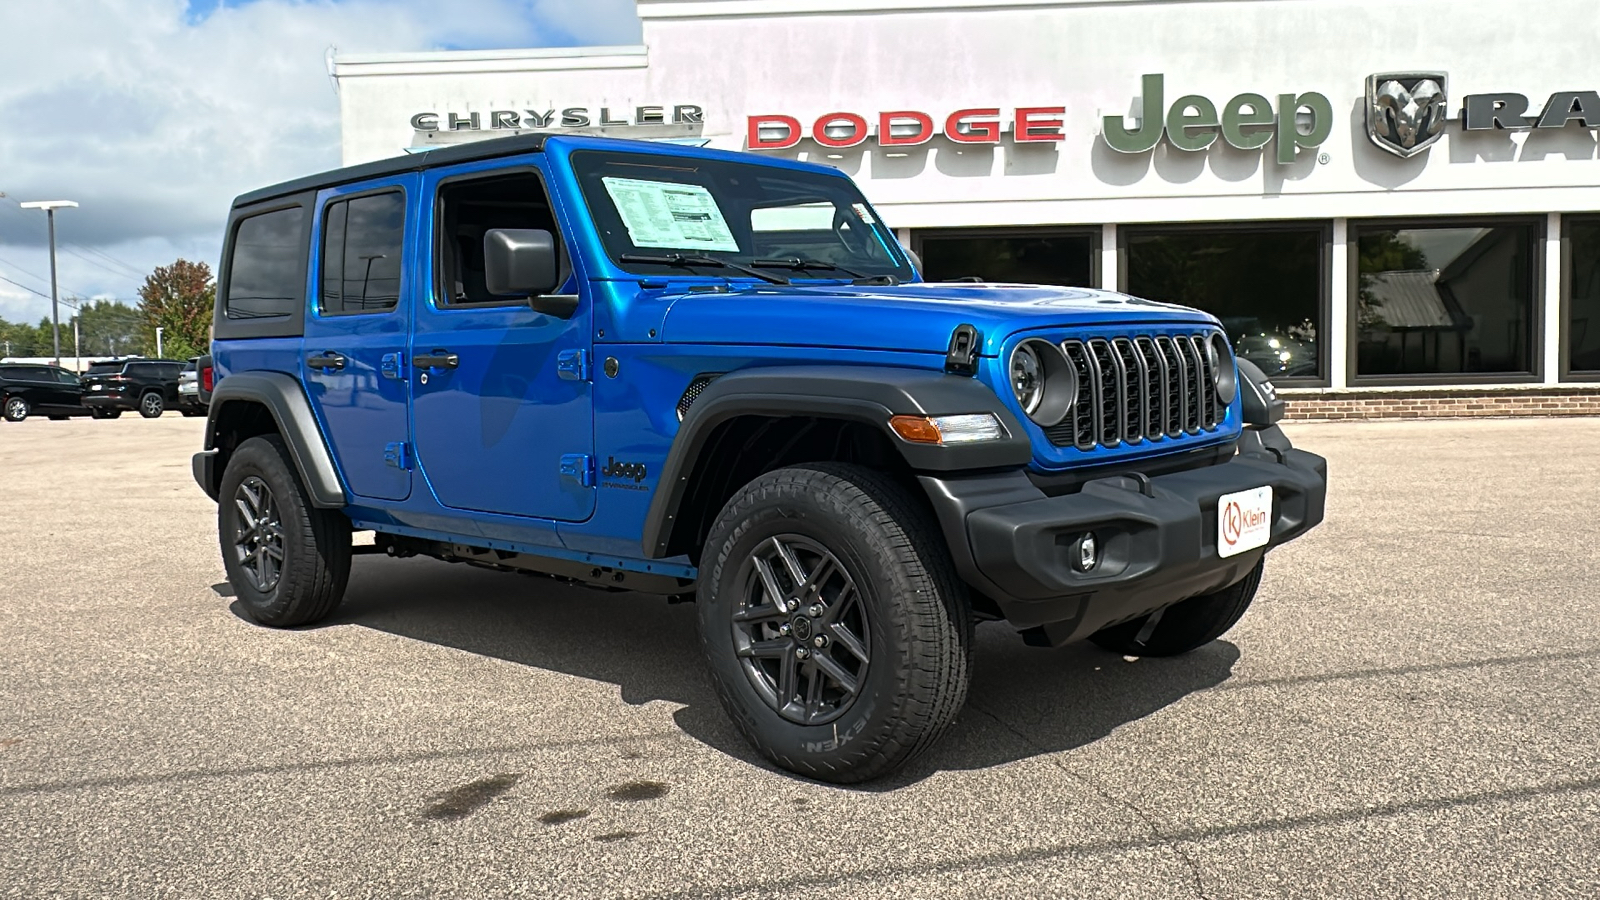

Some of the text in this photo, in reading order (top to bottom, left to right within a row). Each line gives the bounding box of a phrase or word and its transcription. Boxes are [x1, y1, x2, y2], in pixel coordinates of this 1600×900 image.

[410, 104, 705, 131] CHRYSLER
[747, 106, 1066, 150] DODGE
[1103, 73, 1333, 164] Jeep
[602, 456, 647, 483] Jeep
[1243, 507, 1266, 529] Klein
